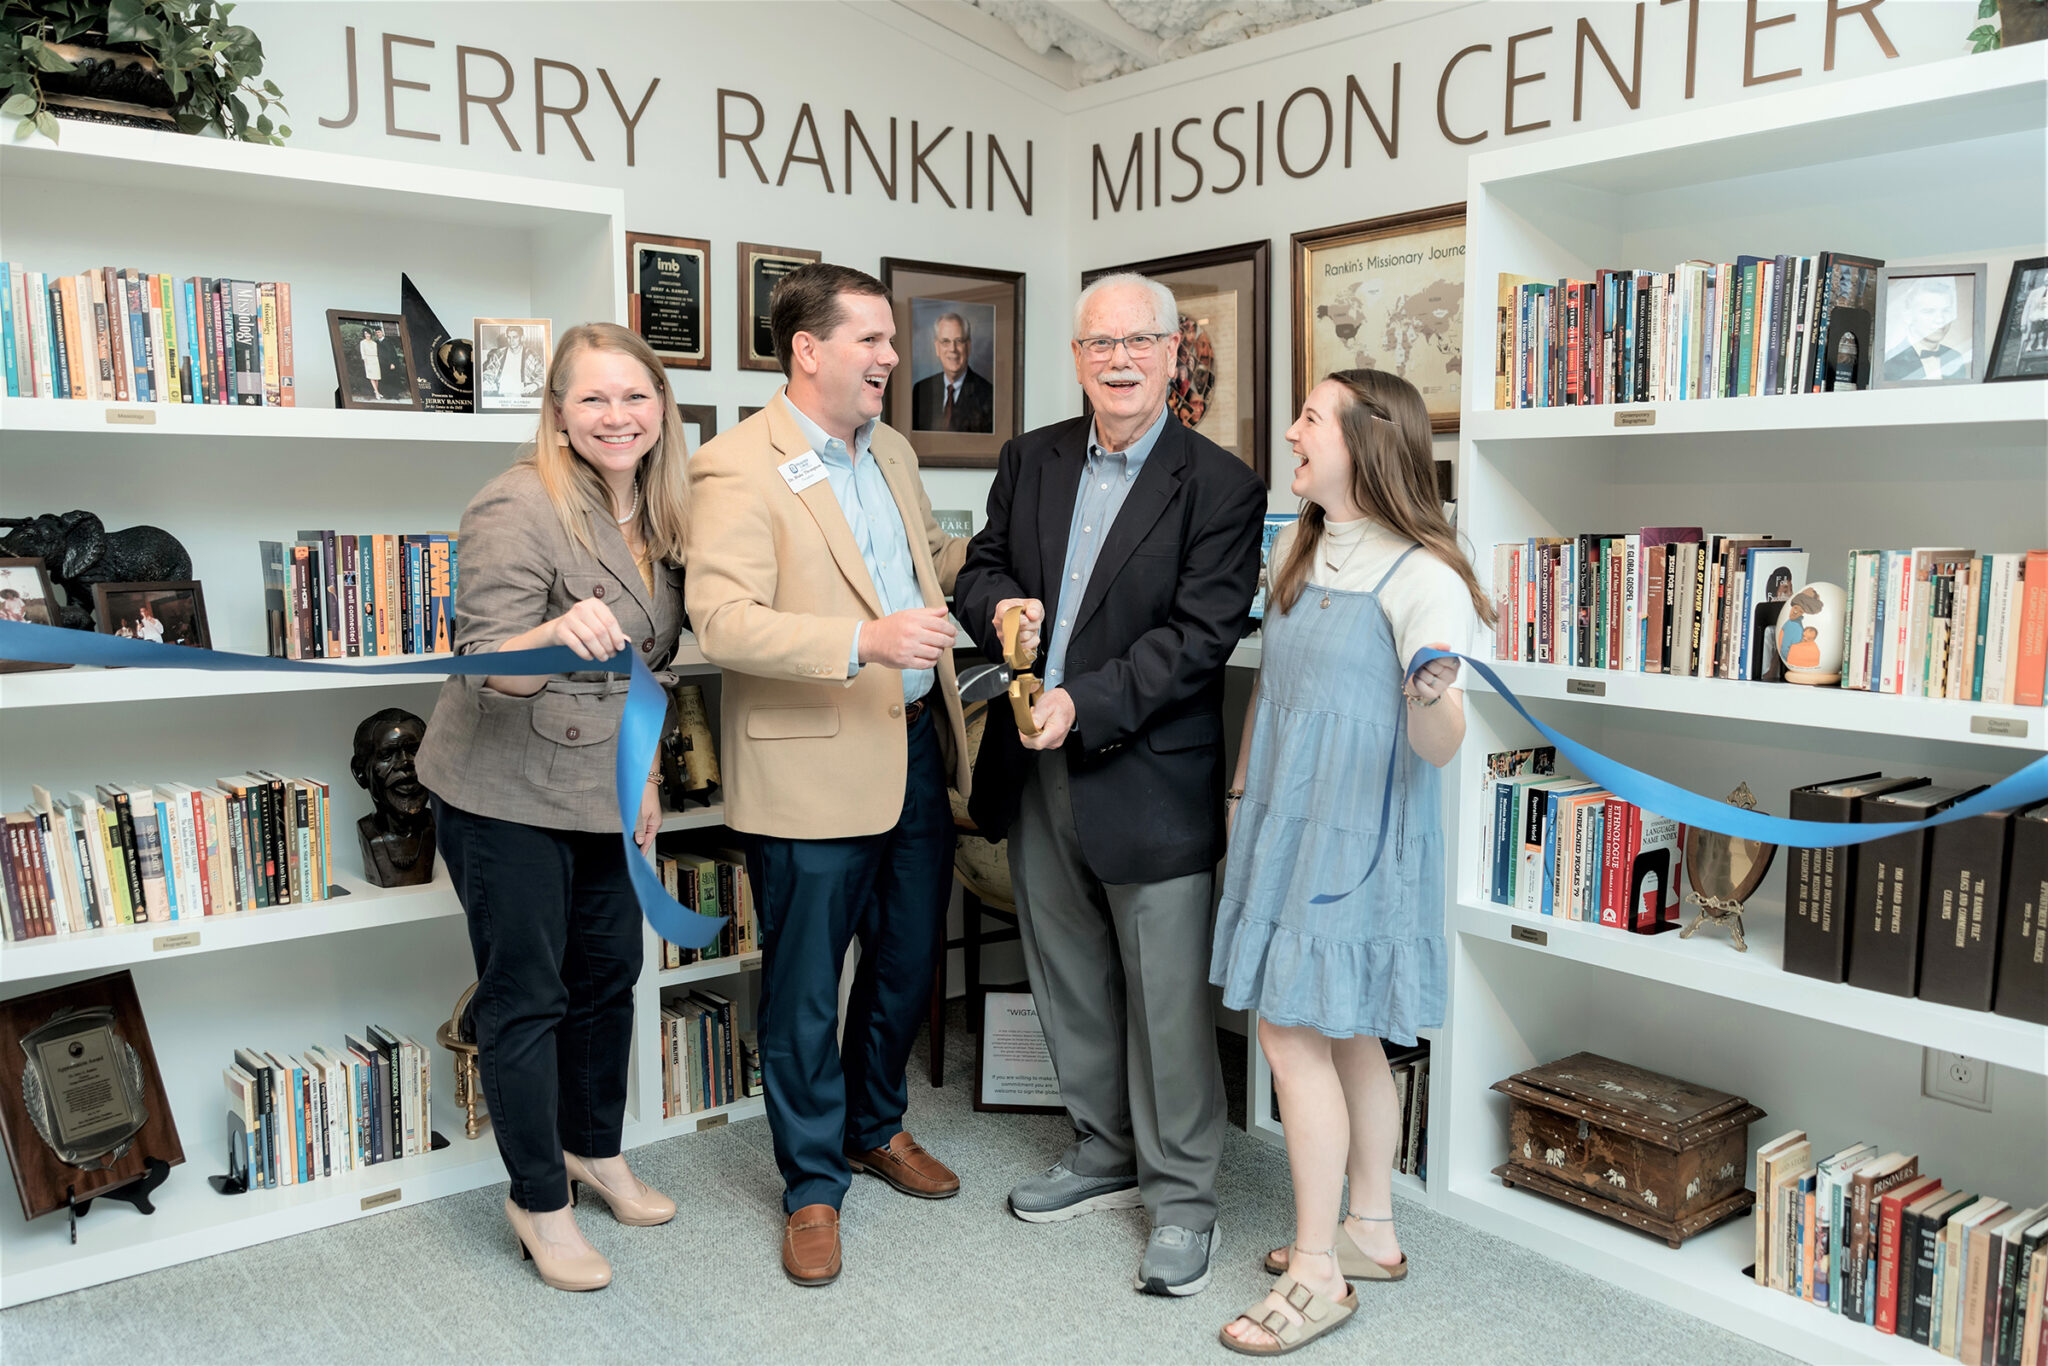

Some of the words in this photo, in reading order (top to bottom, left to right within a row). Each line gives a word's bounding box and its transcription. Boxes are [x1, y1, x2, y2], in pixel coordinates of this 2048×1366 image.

[318, 25, 661, 168] JERRY
[717, 87, 1034, 217] RANKIN
[1092, 61, 1402, 221] MISSION
[1435, 0, 1900, 146] CENTER
[657, 257, 680, 272] imb
[1325, 259, 1364, 276] Rankin's
[1368, 252, 1423, 270] Missionary
[1428, 245, 1466, 260] Journe
[1745, 281, 1753, 294] THE
[1747, 272, 1753, 280] IN
[163, 284, 171, 309] Biblical
[1735, 283, 1743, 310] WALKING
[165, 310, 173, 339] Theology
[236, 288, 255, 345] Missiology
[263, 303, 272, 335] Missiology
[1744, 308, 1752, 320] FOR
[1770, 321, 1778, 350] CHOOSE
[169, 349, 177, 378] Missions
[1626, 551, 1635, 576] GLOBAL
[1626, 576, 1634, 602] GOSPEL
[1697, 572, 1704, 583] OF
[1611, 592, 1619, 629] Understandings?
[1695, 583, 1703, 612] POWER
[1876, 601, 1884, 621] FIRST
[2029, 586, 2038, 620] CHURCH
[348, 605, 357, 642] connected
[2034, 588, 2048, 655] UNDERSTANDING
[2024, 621, 2036, 657] GROWTH
[1611, 805, 1621, 869] ETHNOLOGUE
[1642, 835, 1659, 846] NAME
[1660, 832, 1677, 842] INDEX
[1645, 824, 1676, 837] LANGUAGE
[79, 839, 89, 866] Mountain
[1801, 849, 1809, 882] PRESIDENT
[1813, 848, 1822, 874] FOREIGN
[1826, 848, 1834, 873] LECTION
[129, 860, 138, 881] WALLACE
[134, 889, 142, 904] CHINA
[1799, 883, 1808, 899] JUNE
[1812, 874, 1821, 901] MISSION
[1824, 874, 1833, 888] AND
[1893, 882, 1903, 904] BOARD
[1960, 870, 1971, 891] BLOGS
[1810, 901, 1820, 923] BOARD
[1822, 888, 1833, 932] INSTALLATION
[1941, 889, 1953, 920] COLUMNS
[1959, 892, 1969, 907] AND
[1972, 895, 1984, 922] RANKIN
[2037, 880, 2048, 928] APPOINTMENT
[1891, 904, 1902, 934] REPORTS
[1955, 907, 1967, 948] COMMISSION
[2033, 928, 2047, 964] MESSAGES
[391, 1048, 399, 1097] TRANSFORMISSION
[1874, 1166, 1914, 1194] PRISONERS
[1882, 1217, 1896, 1233] Fire
[1882, 1233, 1893, 1244] on
[1881, 1246, 1893, 1259] the
[1879, 1259, 1893, 1299] Mountains
